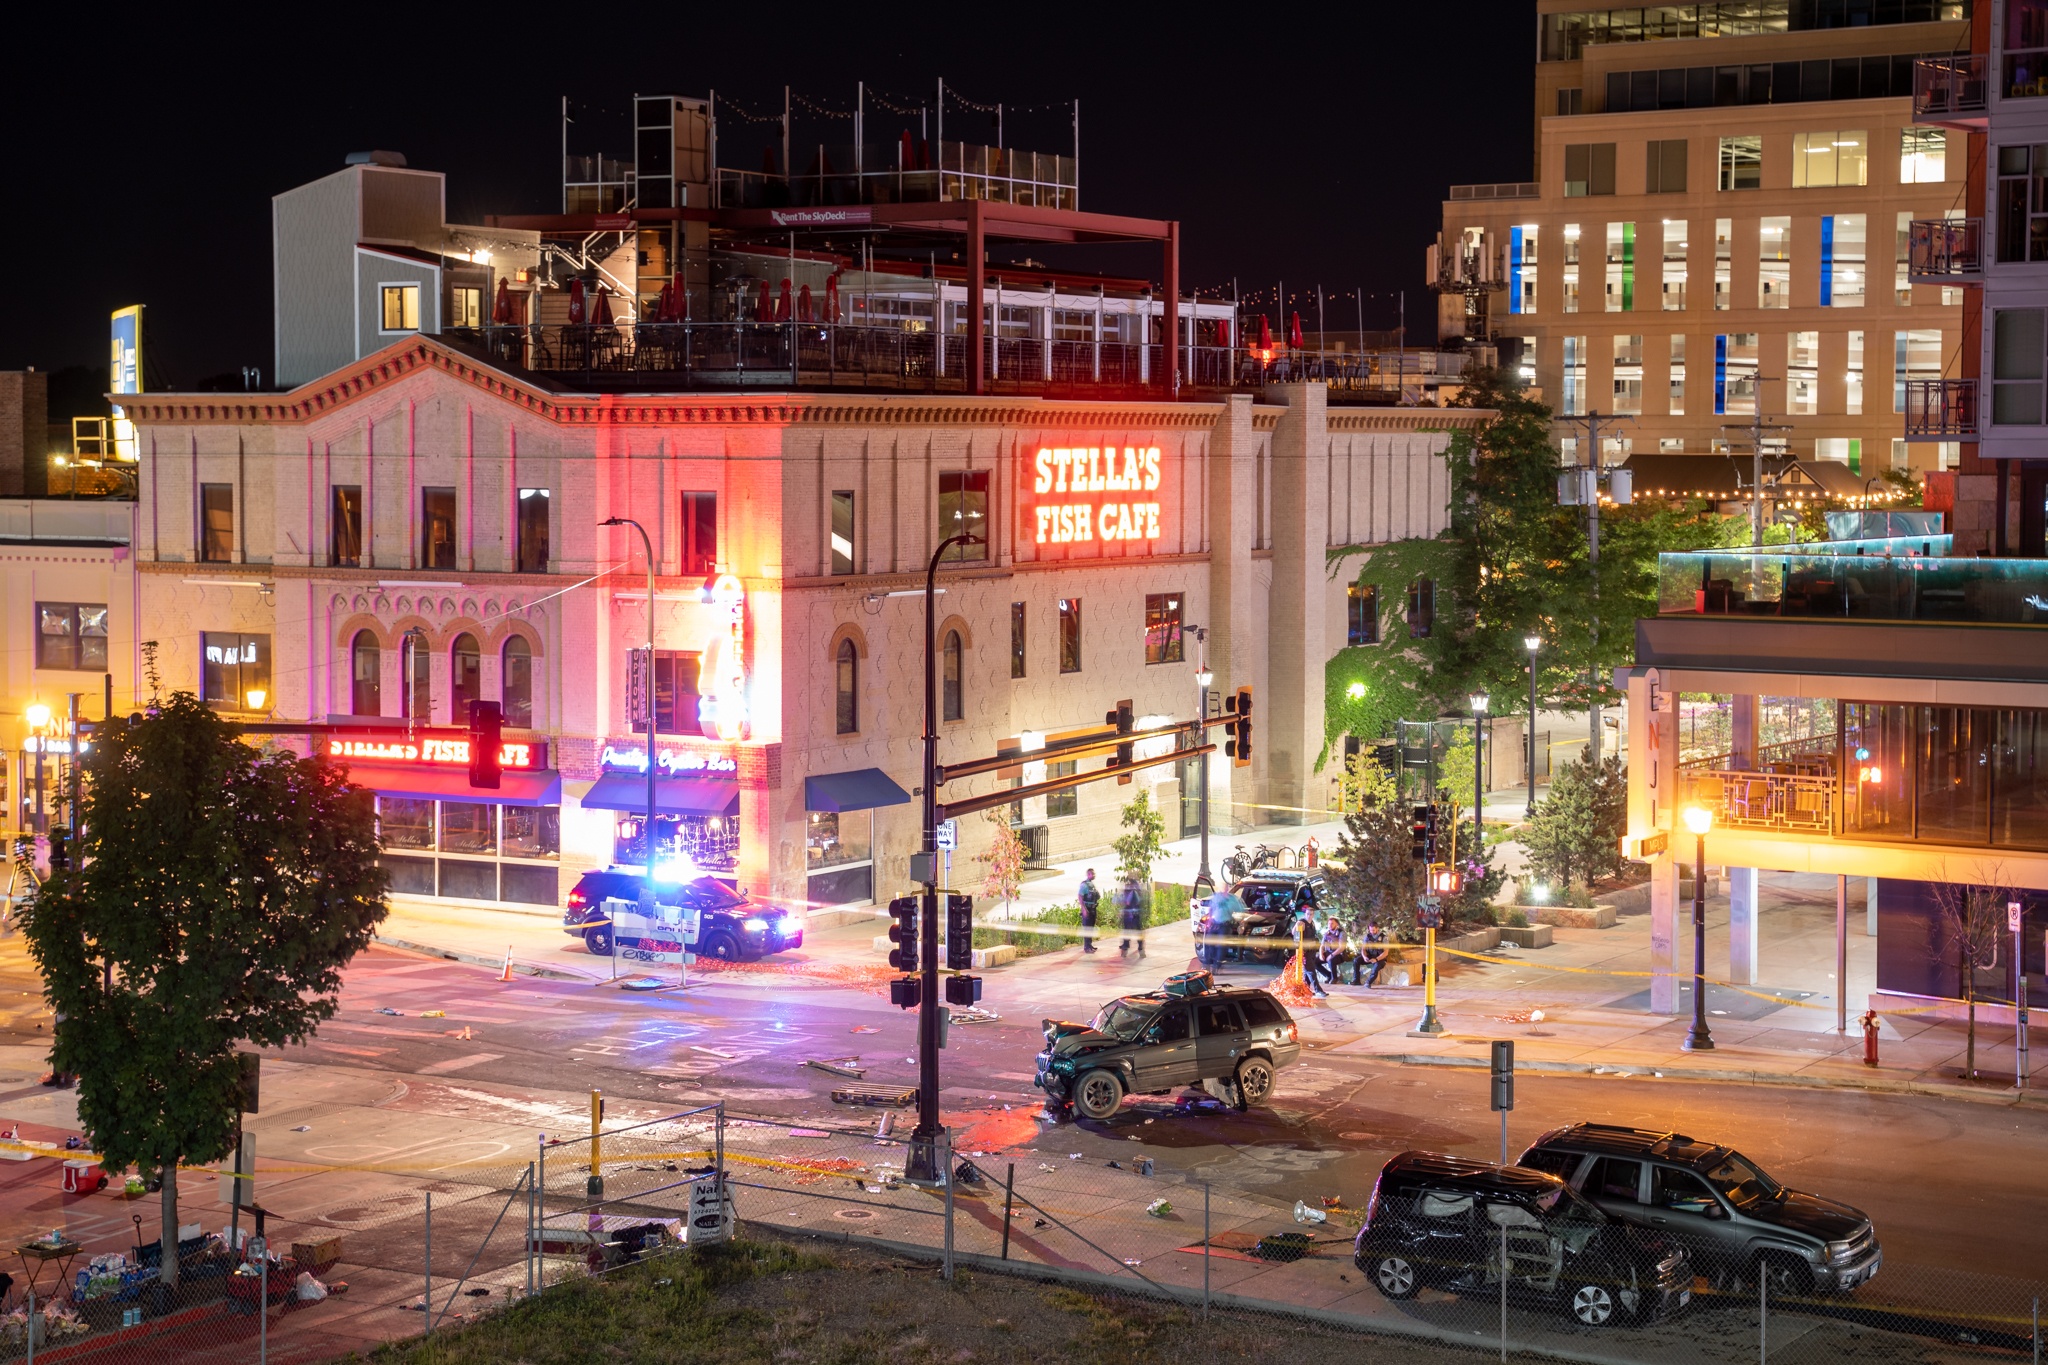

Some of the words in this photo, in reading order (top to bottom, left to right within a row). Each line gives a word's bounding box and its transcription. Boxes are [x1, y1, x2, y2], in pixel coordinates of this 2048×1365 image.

[781, 213, 798, 222] Rent
[798, 212, 812, 221] The
[812, 211, 846, 222] SkyDeck!
[1035, 447, 1161, 493] STELLA'S
[1035, 504, 1093, 544] FISH
[1099, 503, 1161, 541] CAFE
[632, 650, 640, 721] UPTOWN
[422, 738, 471, 762] FISH
[498, 743, 530, 766] FE
[707, 752, 737, 772] Bar
[937, 830, 953, 838] WAY
[938, 822, 952, 830] ONE
